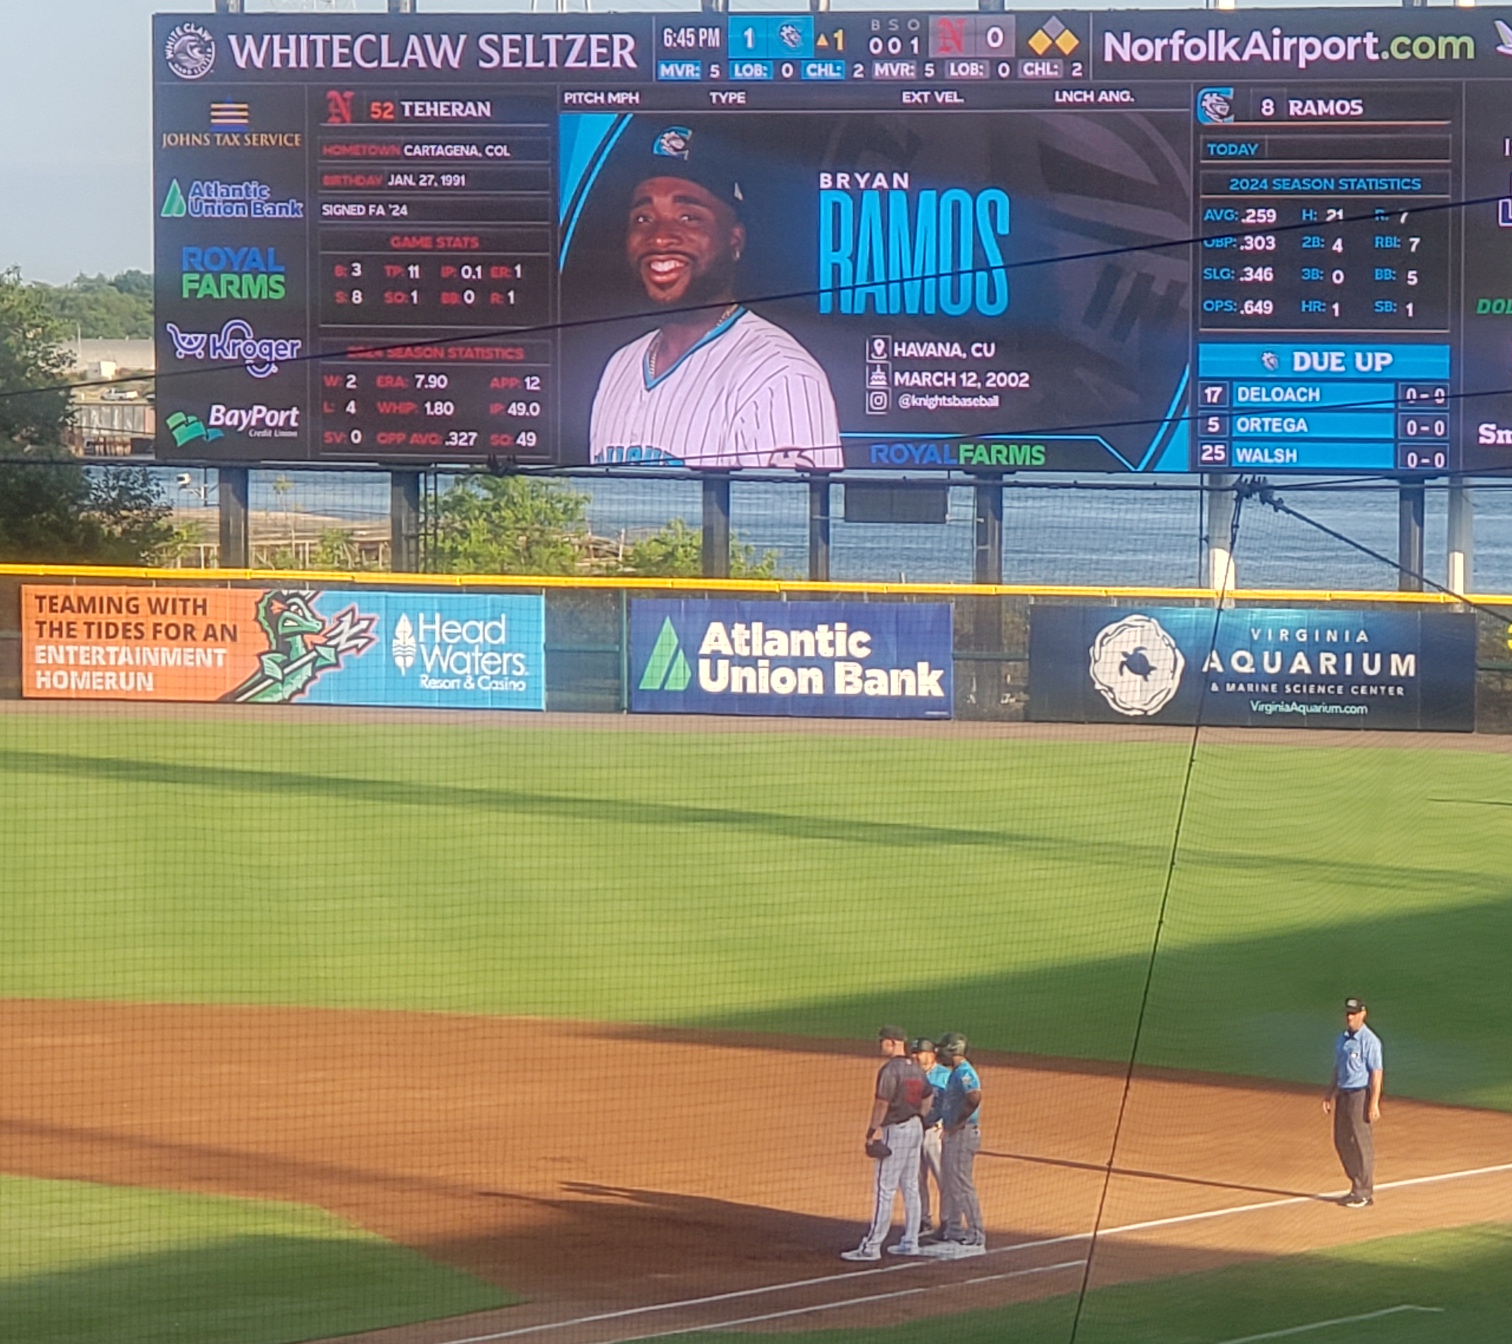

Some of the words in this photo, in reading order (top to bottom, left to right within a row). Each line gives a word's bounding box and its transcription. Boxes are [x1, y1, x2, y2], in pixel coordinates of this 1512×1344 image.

[165, 26, 184, 59] WHITE
[183, 22, 213, 41] CLAW
[663, 28, 696, 48] 6:45
[699, 28, 720, 48] PM
[227, 34, 466, 70] WHITECLAW
[478, 33, 638, 69] SELTZER
[1103, 27, 1475, 69] NorfolkAirport.com
[659, 63, 701, 77] MVR:
[709, 63, 720, 78] 5
[734, 63, 768, 77] LOB:
[806, 62, 842, 77] CHL:
[853, 63, 865, 78] 2
[874, 62, 915, 77] MVR:
[950, 62, 984, 77] LOB:
[1023, 62, 1058, 76] CHL:
[1071, 62, 1083, 77] 2
[564, 91, 605, 104] PITCH
[607, 91, 639, 104] MPH
[709, 91, 746, 105] TYPE
[902, 91, 930, 104] EXT
[1054, 90, 1094, 102] LNCH
[1097, 90, 1134, 103] ANG.
[369, 102, 395, 119] 52
[401, 100, 491, 118] TEHERAN
[1260, 99, 1275, 117] 8
[1288, 98, 1364, 117] RAMOS
[161, 132, 210, 149] JOHNS
[213, 133, 243, 147] TAX
[244, 132, 302, 148] SERVICE
[322, 145, 400, 156] HOMETOWN
[485, 145, 510, 157] COL
[1207, 143, 1259, 156] TODAY
[322, 175, 383, 187] BIRTHDAY
[387, 173, 417, 187] JAN.
[439, 173, 466, 187] 1991
[820, 172, 910, 189] BRYAN
[1229, 178, 1268, 192] 2024
[1272, 177, 1335, 192] SEASON
[1338, 177, 1421, 191] STATISTICS
[188, 180, 271, 200] Atlantic
[188, 199, 247, 218] Union
[250, 200, 304, 218] Bank
[321, 204, 366, 217] SIGNED
[369, 204, 386, 217] FA
[1204, 209, 1238, 222] AVG:
[1241, 209, 1277, 224] .259
[390, 236, 432, 249] GAME
[434, 236, 479, 249] STATS
[1240, 236, 1276, 252] .303
[1302, 237, 1325, 250] 2B:
[1375, 237, 1401, 250] RBI:
[182, 247, 285, 273] ROYAL
[818, 189, 1010, 316] RAMOS
[407, 264, 420, 279] 11
[460, 264, 482, 279] 0.1
[1203, 268, 1235, 281] SLG:
[1239, 267, 1274, 282] .346
[1302, 268, 1324, 280] 3B:
[1374, 268, 1396, 280] BB:
[182, 273, 285, 299] FARMS
[1203, 300, 1237, 313] OPS:
[1239, 300, 1274, 315] .649
[1302, 300, 1326, 312] HR:
[1374, 301, 1397, 313] SB:
[209, 319, 301, 379] Kroger
[387, 346, 444, 359] SEASON
[447, 346, 524, 359] STATISTICS
[893, 342, 967, 359] HAVANA,
[969, 342, 995, 358] CU
[1293, 352, 1345, 372] DUE
[1355, 352, 1393, 372] UP
[415, 375, 448, 390] 7.90
[524, 376, 541, 390] 12
[894, 372, 956, 388] MARCH
[959, 372, 983, 390] 12,
[986, 372, 1030, 388] 2002
[899, 393, 999, 409] @knightsbaseball
[1204, 387, 1222, 403] 17
[1237, 387, 1320, 403] DELOACH
[424, 401, 454, 416] 1.80
[506, 402, 540, 417] 49.0
[209, 405, 299, 431] BayPort
[1207, 418, 1220, 433] 5
[1236, 418, 1308, 434] ORTEGA
[248, 429, 270, 438] Credit
[376, 432, 406, 445] OPP
[444, 431, 478, 447] .327
[516, 431, 536, 446] 49
[1201, 446, 1226, 461] 25
[1236, 448, 1298, 464] WALSH
[35, 594, 143, 615] TEAMING
[149, 597, 208, 617] WITH
[35, 621, 79, 640] THE
[83, 620, 147, 640] TIDES
[152, 621, 198, 642] FOR
[202, 622, 238, 643] AN
[418, 613, 506, 644] Head
[1250, 628, 1369, 644] VIRGINIA
[699, 621, 872, 657] Atlantic
[34, 646, 227, 667] ENTERTAINMENT
[419, 644, 526, 675] Waters
[1202, 650, 1416, 678] AQUARIUM
[35, 671, 154, 691] HOMERUN
[419, 676, 461, 690] Resort
[463, 676, 476, 690] &
[477, 676, 525, 691] Casino
[699, 660, 826, 694] Union
[834, 662, 945, 697] Bank
[1211, 682, 1220, 692] &
[1226, 682, 1280, 694] MARINE
[1284, 684, 1344, 695] SCIENCE
[1350, 685, 1404, 696] CENTER
[1250, 700, 1368, 716] VirginiaAquarium.com
